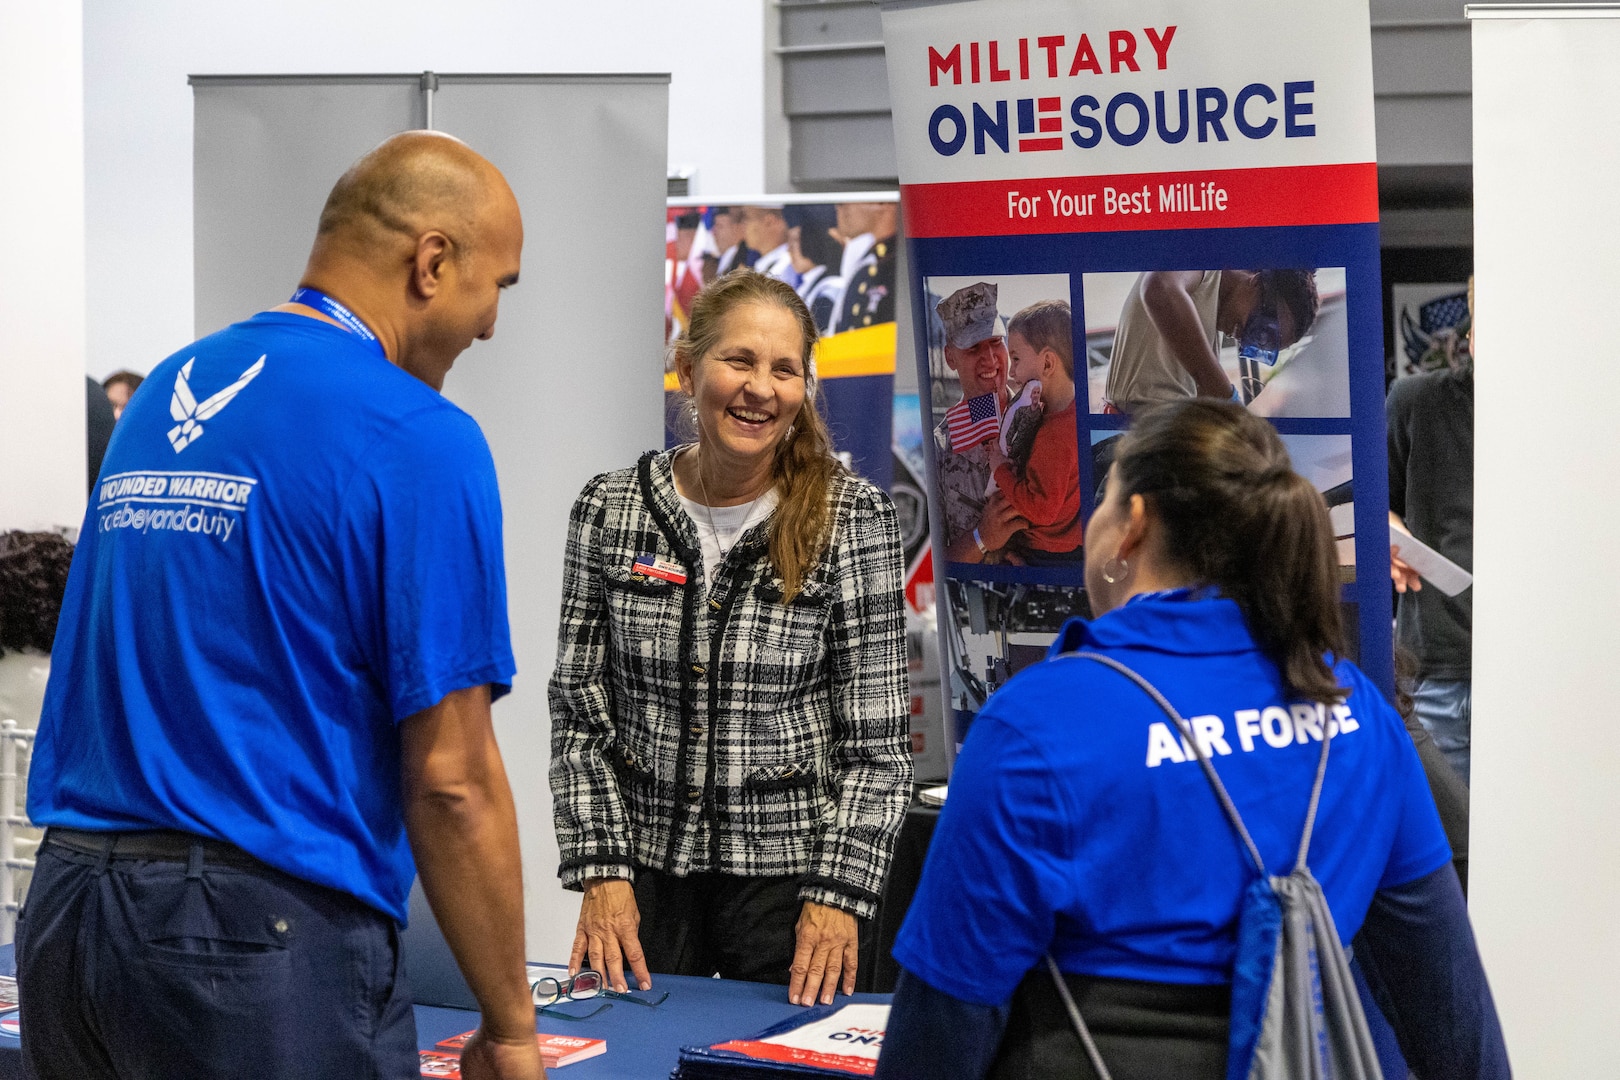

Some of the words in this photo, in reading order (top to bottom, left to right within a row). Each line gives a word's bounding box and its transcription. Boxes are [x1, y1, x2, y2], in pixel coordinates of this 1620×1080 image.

[928, 25, 1177, 87] MILITARY
[928, 80, 1316, 157] ONESOURCE
[1007, 190, 1041, 219] For
[1047, 187, 1097, 217] Your
[1103, 184, 1151, 215] Best
[1159, 181, 1228, 214] MilLife
[168, 476, 252, 504] WARRIOR
[1145, 714, 1233, 768] AIR
